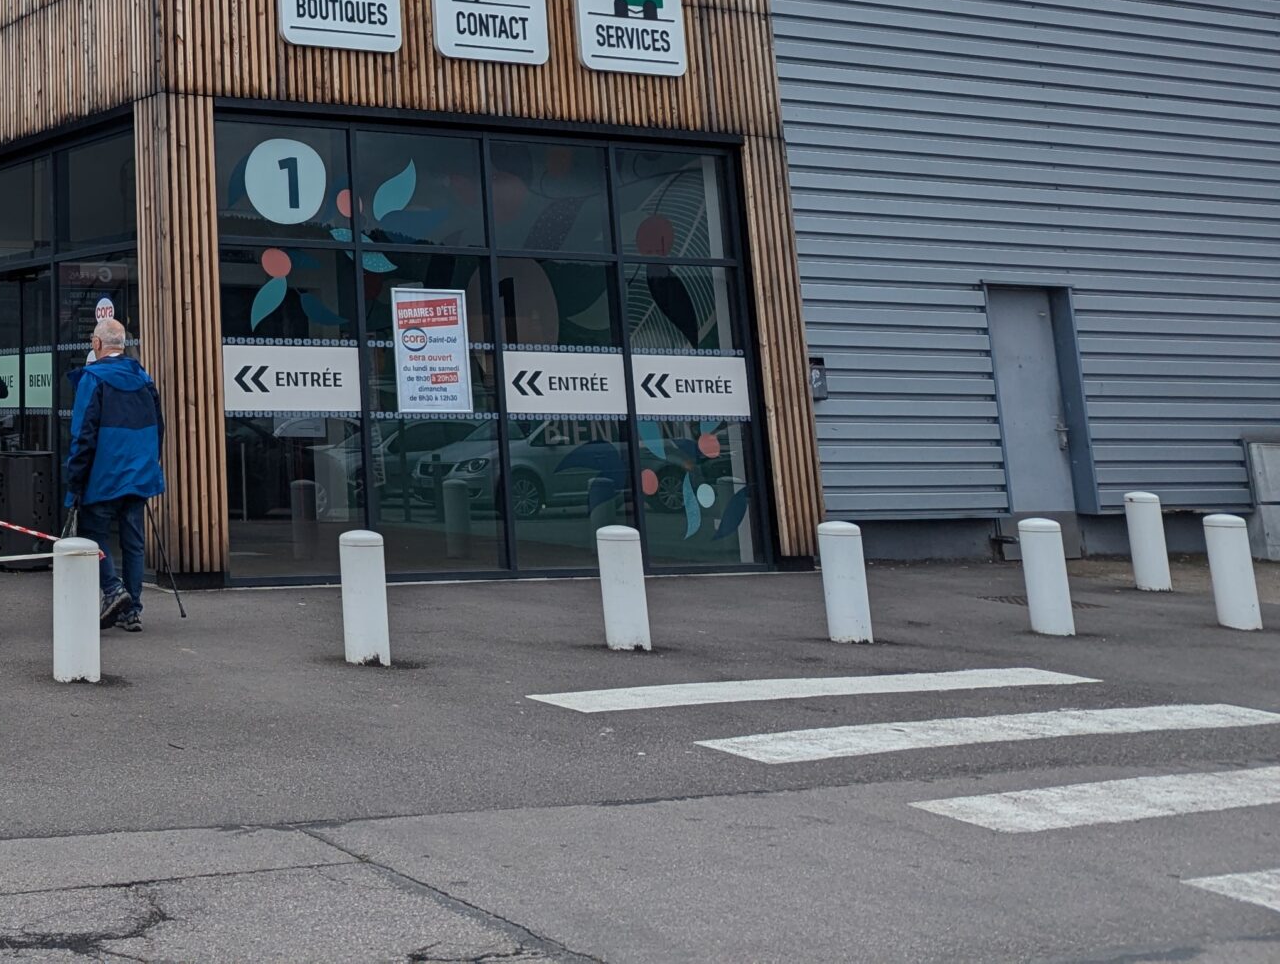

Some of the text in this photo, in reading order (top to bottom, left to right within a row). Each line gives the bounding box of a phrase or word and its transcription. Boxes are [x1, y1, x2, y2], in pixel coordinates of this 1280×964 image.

[456, 10, 529, 41] CONTACT
[595, 23, 671, 53] SERVICES
[277, 156, 300, 209] 1
[96, 306, 113, 319] cora
[397, 307, 434, 319] HORAIRES
[403, 334, 458, 344] cora Saint-Dié
[408, 354, 452, 362] sera ouvert
[275, 368, 343, 388] ENTRÉE
[437, 374, 458, 382] 20h30
[548, 372, 609, 392] ENTRÉE
[675, 375, 733, 394] ENTRÉE
[418, 385, 448, 393] dimanche
